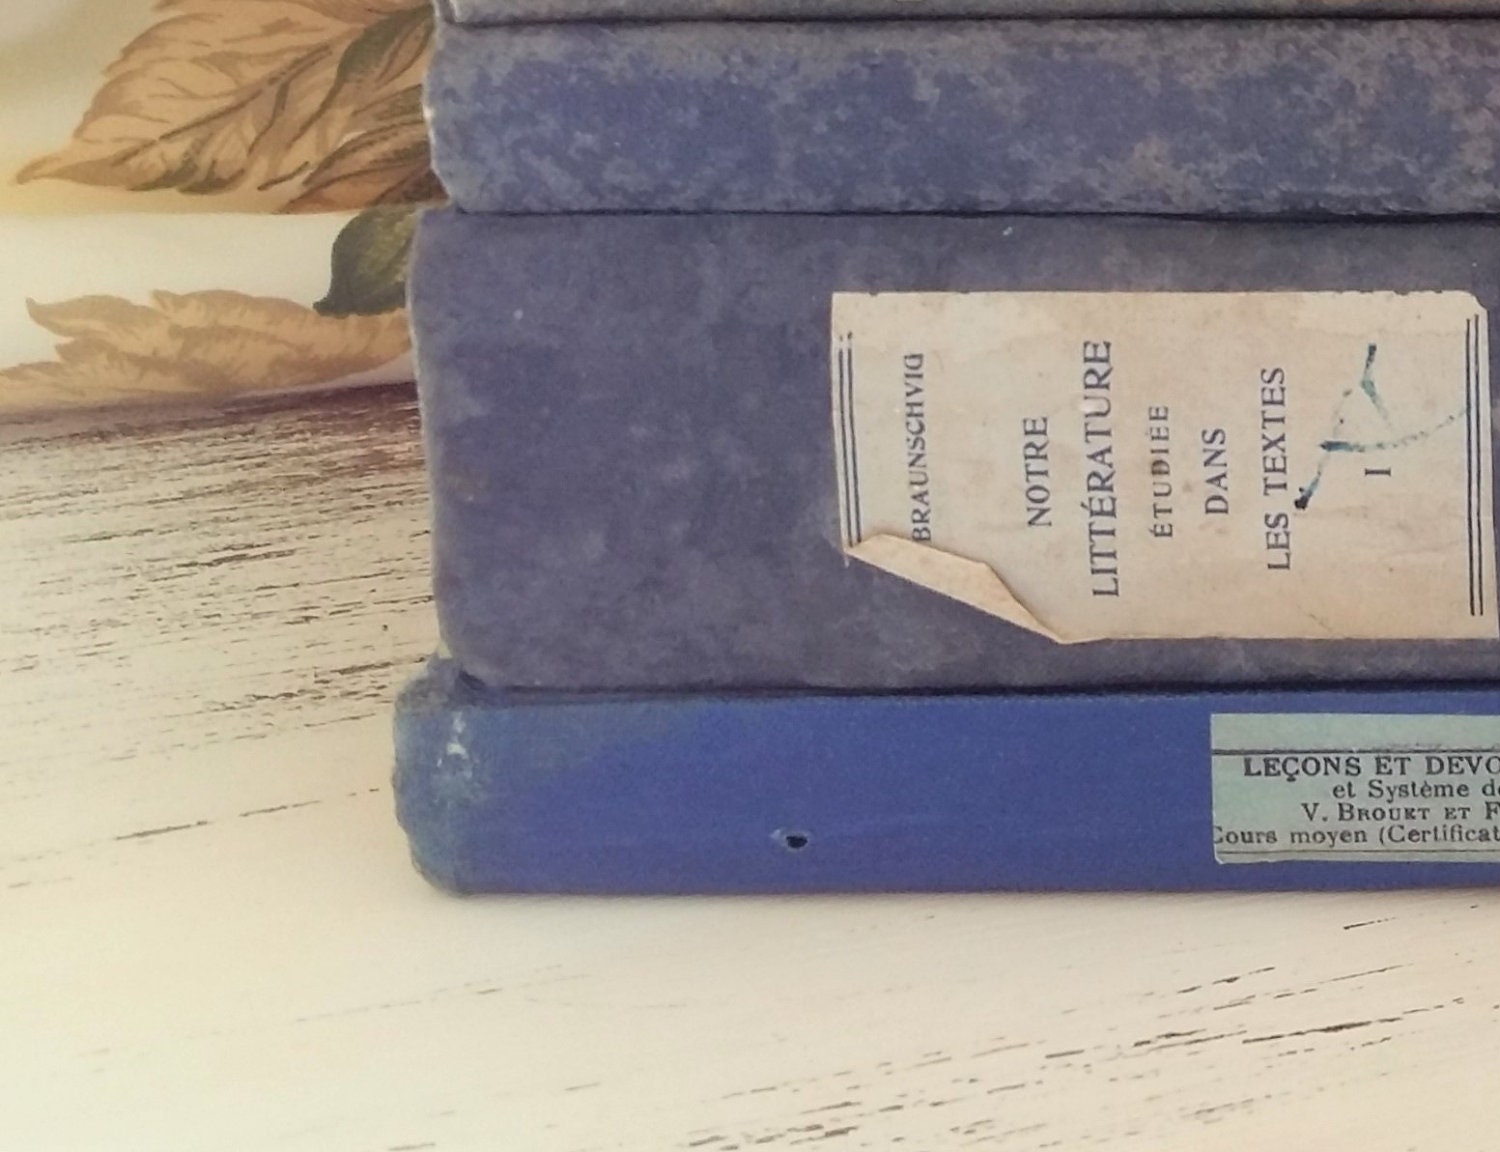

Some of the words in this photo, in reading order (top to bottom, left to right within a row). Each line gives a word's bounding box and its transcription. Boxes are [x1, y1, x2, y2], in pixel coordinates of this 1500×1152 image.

[903, 351, 931, 543] BRAUNSCHVIG
[1260, 366, 1288, 497] TEXTES
[1023, 415, 1052, 528] NOTRE
[1080, 339, 1120, 598] LITTÉRATURE
[1201, 427, 1229, 515] DANS
[1364, 467, 1392, 477] I
[1264, 512, 1291, 571] LES
[1243, 756, 1362, 783] LEÇONS
[1374, 755, 1411, 776] ET
[1332, 780, 1357, 799] et
[1367, 779, 1470, 804] Système
[1213, 825, 1278, 845] Cours
[1290, 829, 1368, 848] moyen
[1301, 802, 1329, 822] V.
[1444, 806, 1471, 821] ET
